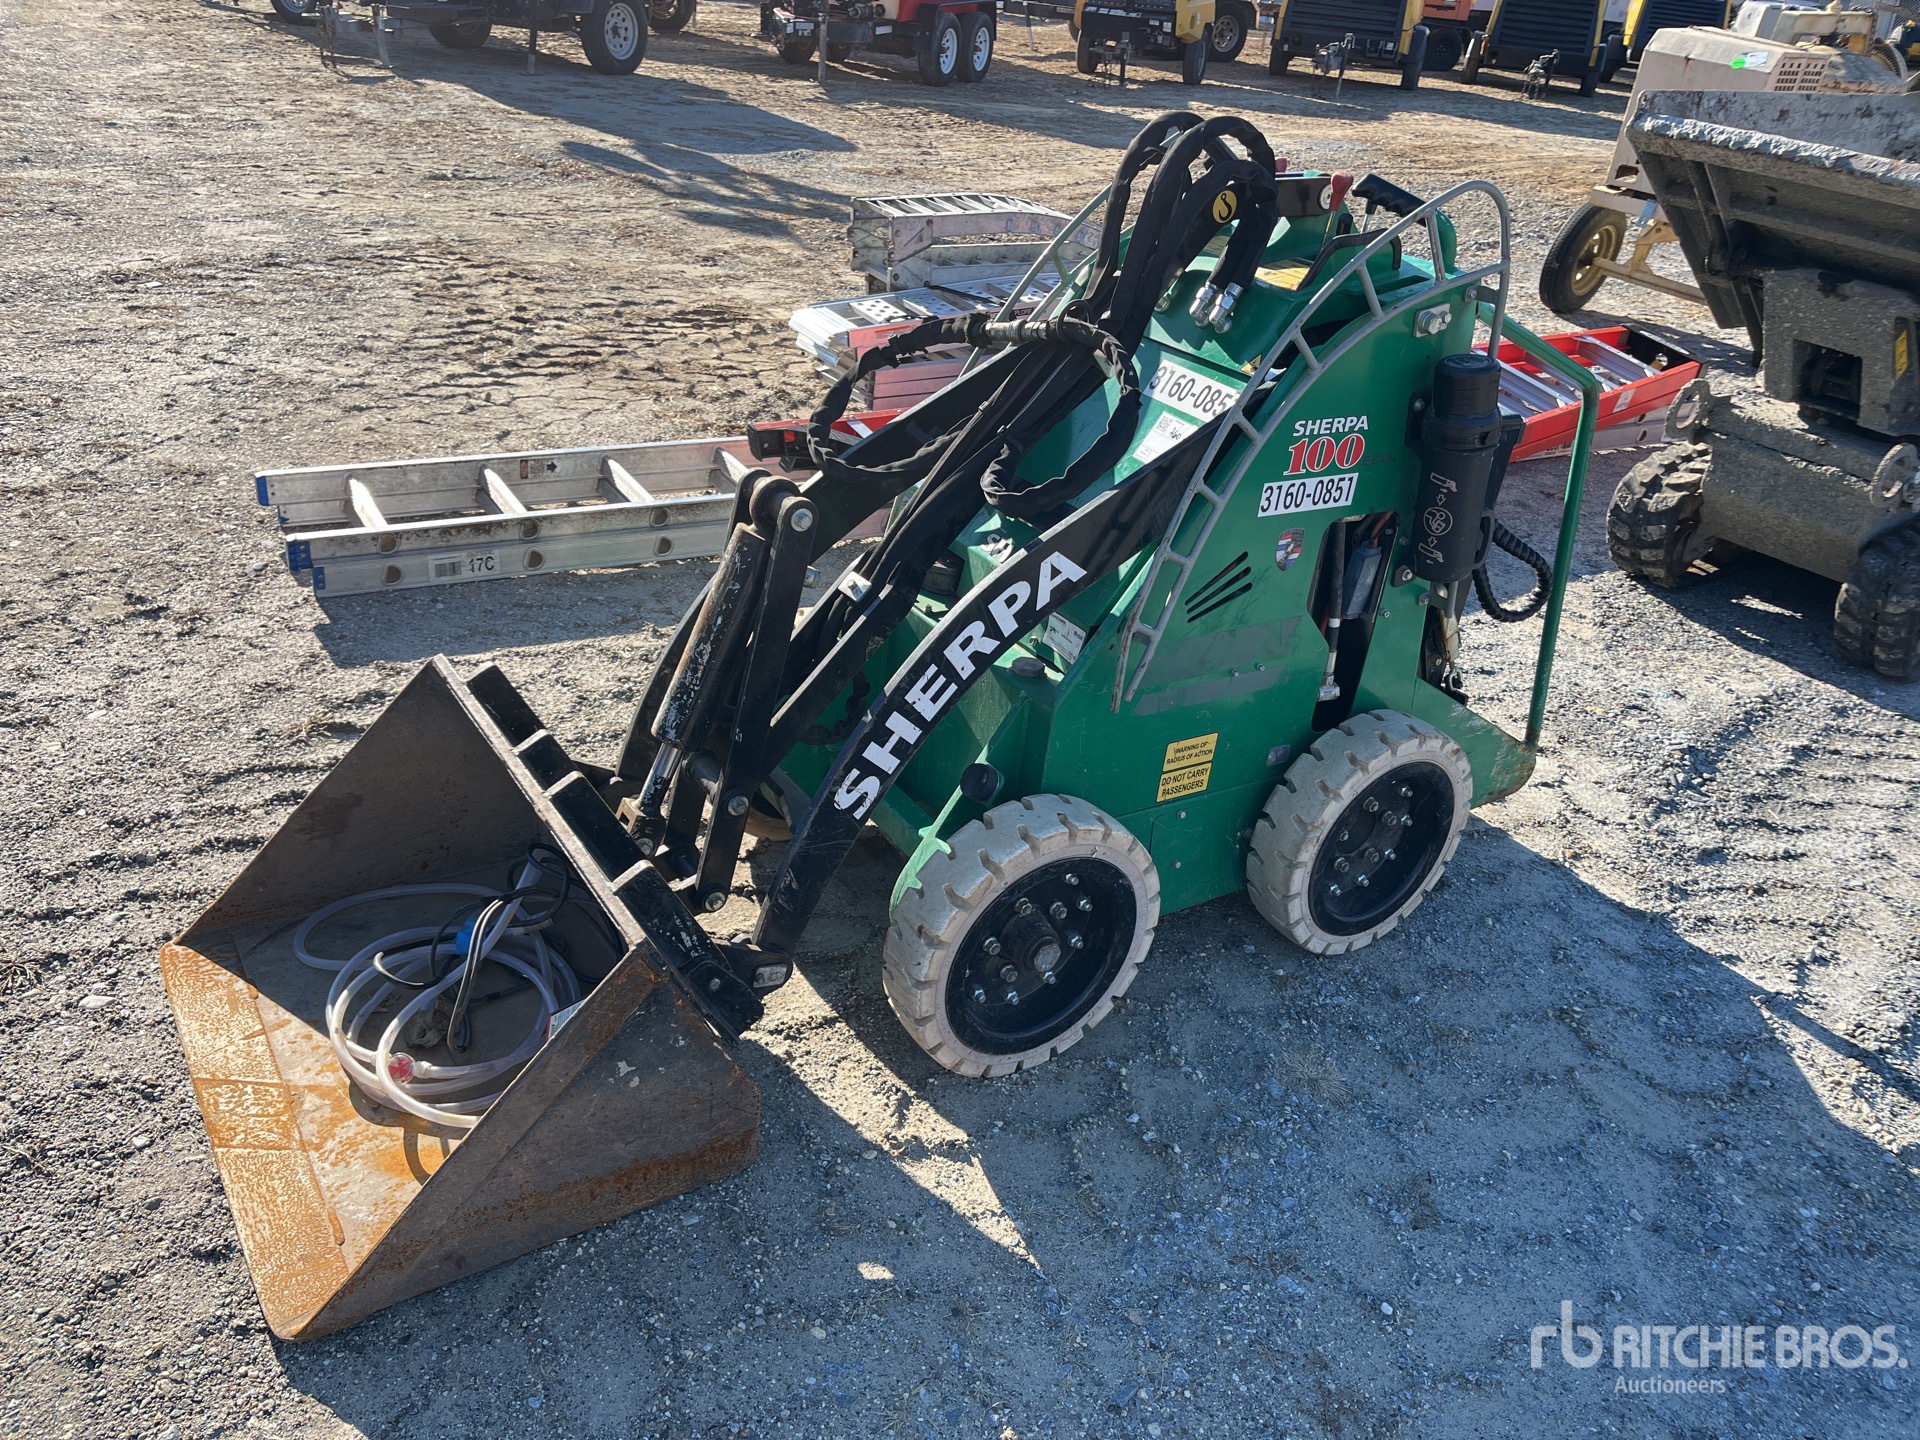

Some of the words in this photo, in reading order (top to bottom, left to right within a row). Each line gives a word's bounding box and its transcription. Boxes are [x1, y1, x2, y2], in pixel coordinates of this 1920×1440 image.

[1149, 365, 1239, 418] 3160-085
[1292, 415, 1369, 437] SHERPA
[1283, 433, 1366, 476] 100
[1260, 476, 1354, 513] 3160-0851
[469, 556, 494, 573] 17C
[833, 551, 1088, 820] SHERPA
[1166, 755, 1185, 764] RADIUS
[1194, 749, 1213, 758] ACTION
[1174, 743, 1199, 754] WARNING
[1161, 777, 1171, 786] DO
[1172, 773, 1186, 783] NOT
[1187, 767, 1209, 779] CARRY
[1161, 779, 1204, 797] PASSENGERS
